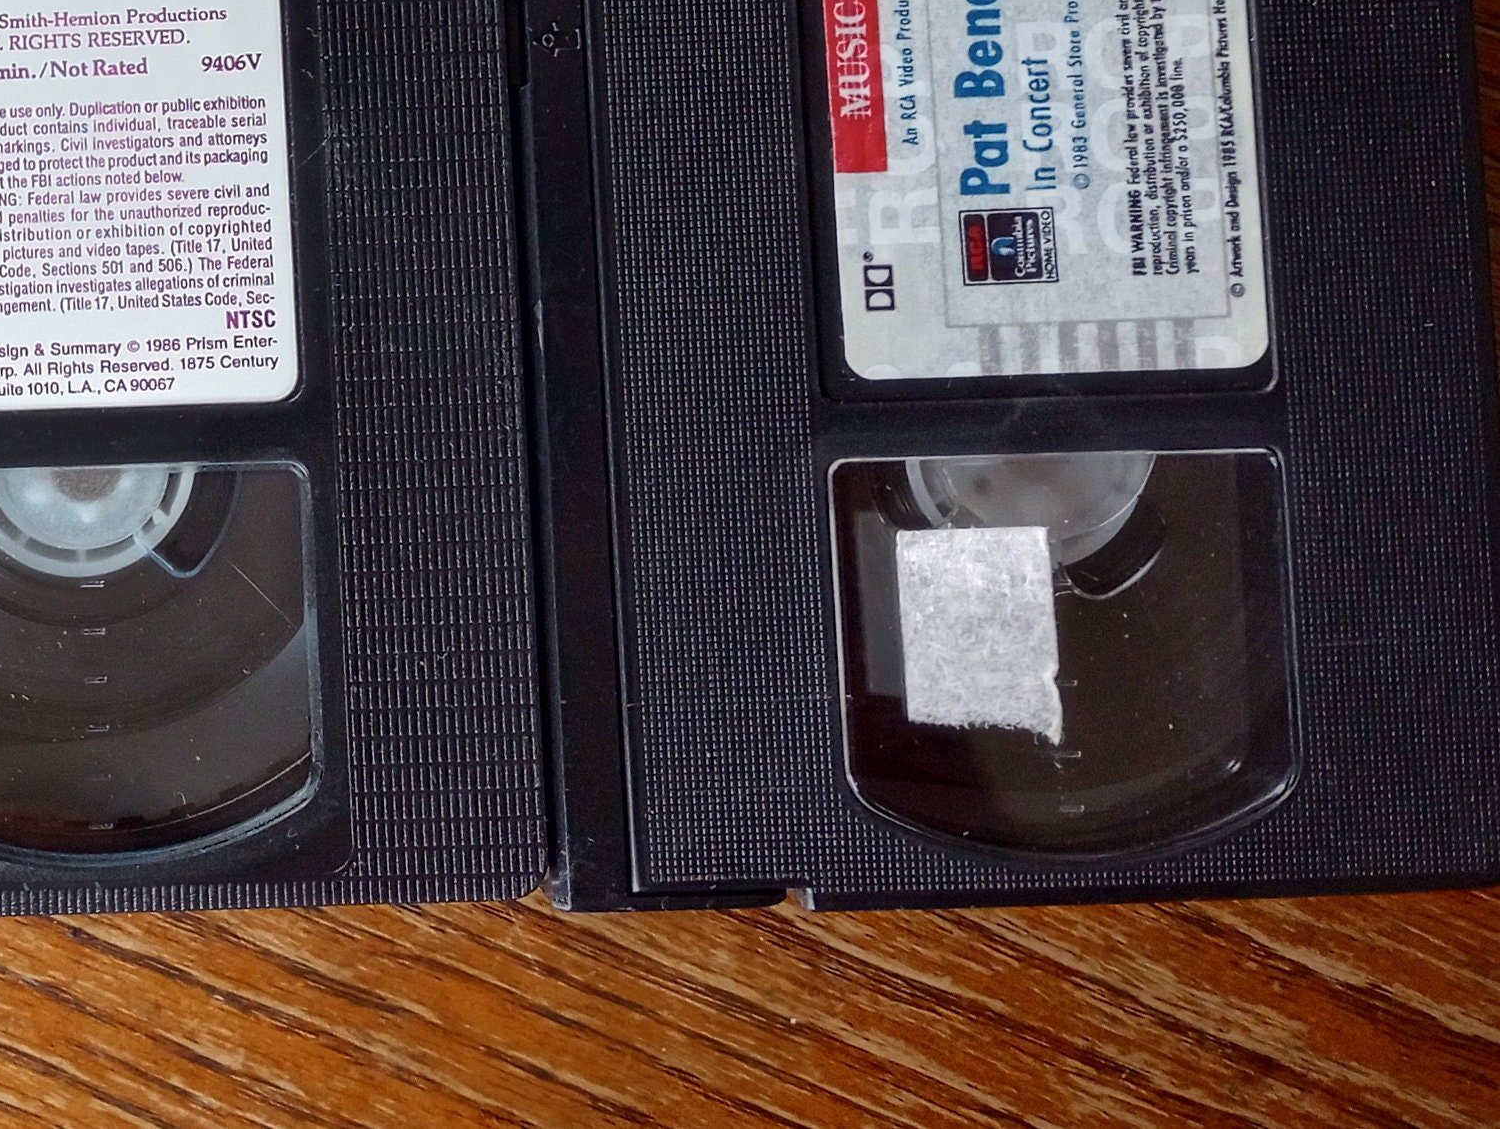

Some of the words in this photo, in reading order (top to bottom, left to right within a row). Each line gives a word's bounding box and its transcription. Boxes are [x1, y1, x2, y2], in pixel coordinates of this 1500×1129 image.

[126, 6, 228, 25] Productions
[9, 32, 82, 51] RIGHTS
[87, 28, 191, 48] RESERVED.
[1066, 30, 1083, 68] Store
[92, 56, 148, 77] Rated
[201, 53, 262, 72] 9406V
[896, 47, 914, 87] Video
[899, 94, 918, 120] RCA
[1021, 57, 1054, 153] Concert
[1066, 74, 1087, 129] General
[33, 119, 89, 136] contains
[93, 116, 161, 133] individual,
[166, 114, 227, 130] traceable
[230, 113, 267, 128] serial
[901, 127, 919, 146] An
[959, 119, 1011, 196] Pat
[1071, 135, 1089, 168] 1983
[1027, 166, 1057, 191] In
[1040, 210, 1052, 244] VIDEO
[968, 225, 984, 270] RCA
[1025, 219, 1037, 273] Pictures
[1043, 247, 1055, 278] HOME
[225, 309, 276, 330] NTSC
[33, 343, 45, 357] &
[50, 342, 122, 357] Summary
[145, 338, 181, 352] 1986
[186, 336, 228, 351] Prism
[233, 334, 278, 349] Enter-
[23, 362, 42, 377] All
[47, 360, 95, 378] Rights
[100, 357, 174, 374] Reserved.
[180, 355, 215, 370] 1875
[219, 354, 279, 371] Century
[27, 381, 64, 396] 1010,
[104, 378, 128, 393] CA
[129, 376, 176, 392] 90067
